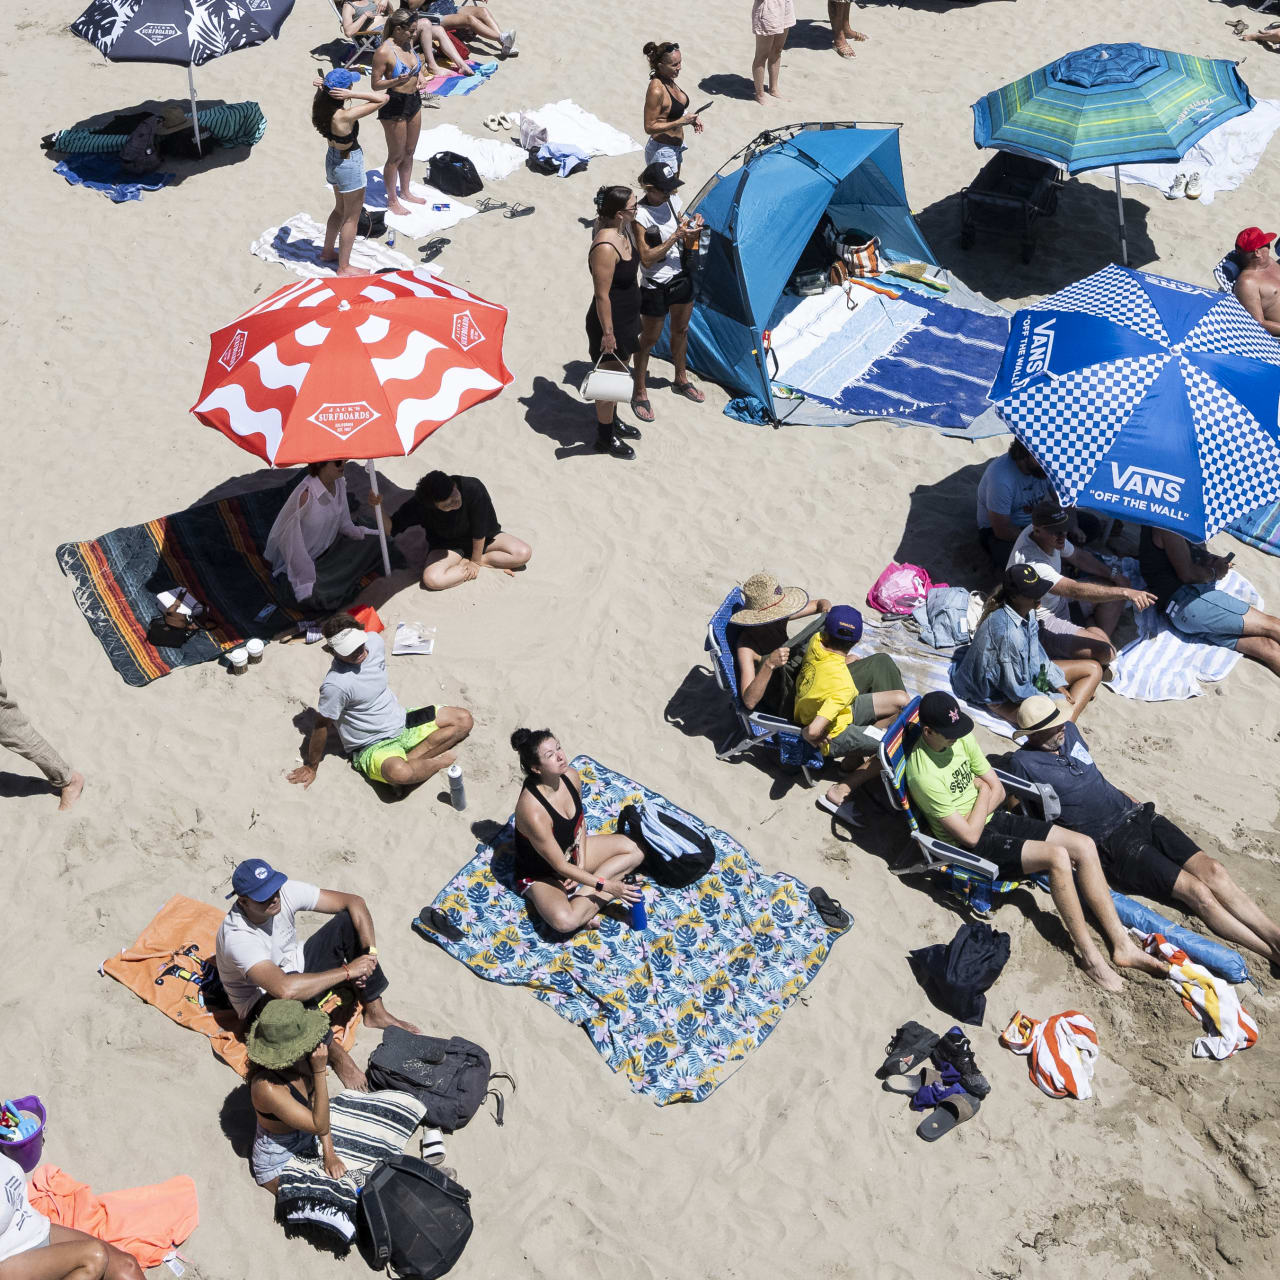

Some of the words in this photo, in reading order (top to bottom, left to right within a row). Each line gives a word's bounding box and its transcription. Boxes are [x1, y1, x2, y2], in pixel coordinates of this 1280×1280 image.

[1022, 314, 1032, 338] "OFF
[1017, 338, 1028, 358] THE
[1025, 317, 1058, 375] VANS
[318, 410, 371, 422] SURFBOARDS
[1111, 461, 1186, 504] VANS
[1090, 488, 1122, 505] "OFF
[1123, 497, 1149, 511] THE
[1150, 504, 1191, 522] WALL"
